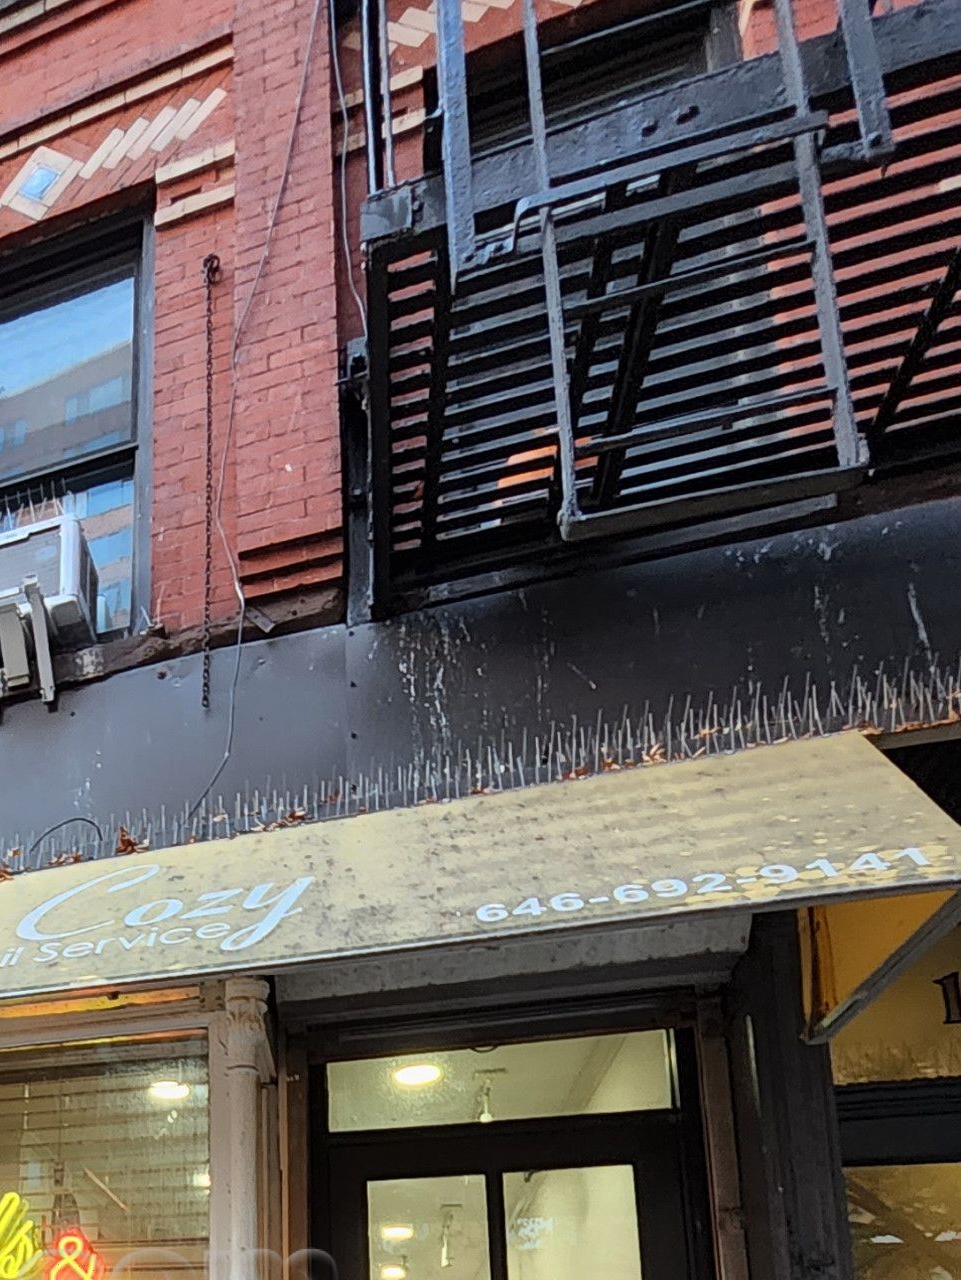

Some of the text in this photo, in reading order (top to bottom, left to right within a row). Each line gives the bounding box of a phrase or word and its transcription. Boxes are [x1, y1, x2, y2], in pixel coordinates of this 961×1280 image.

[17, 864, 314, 952] Cozy
[476, 847, 930, 923] 646-692-9141
[32, 921, 230, 963] Service
